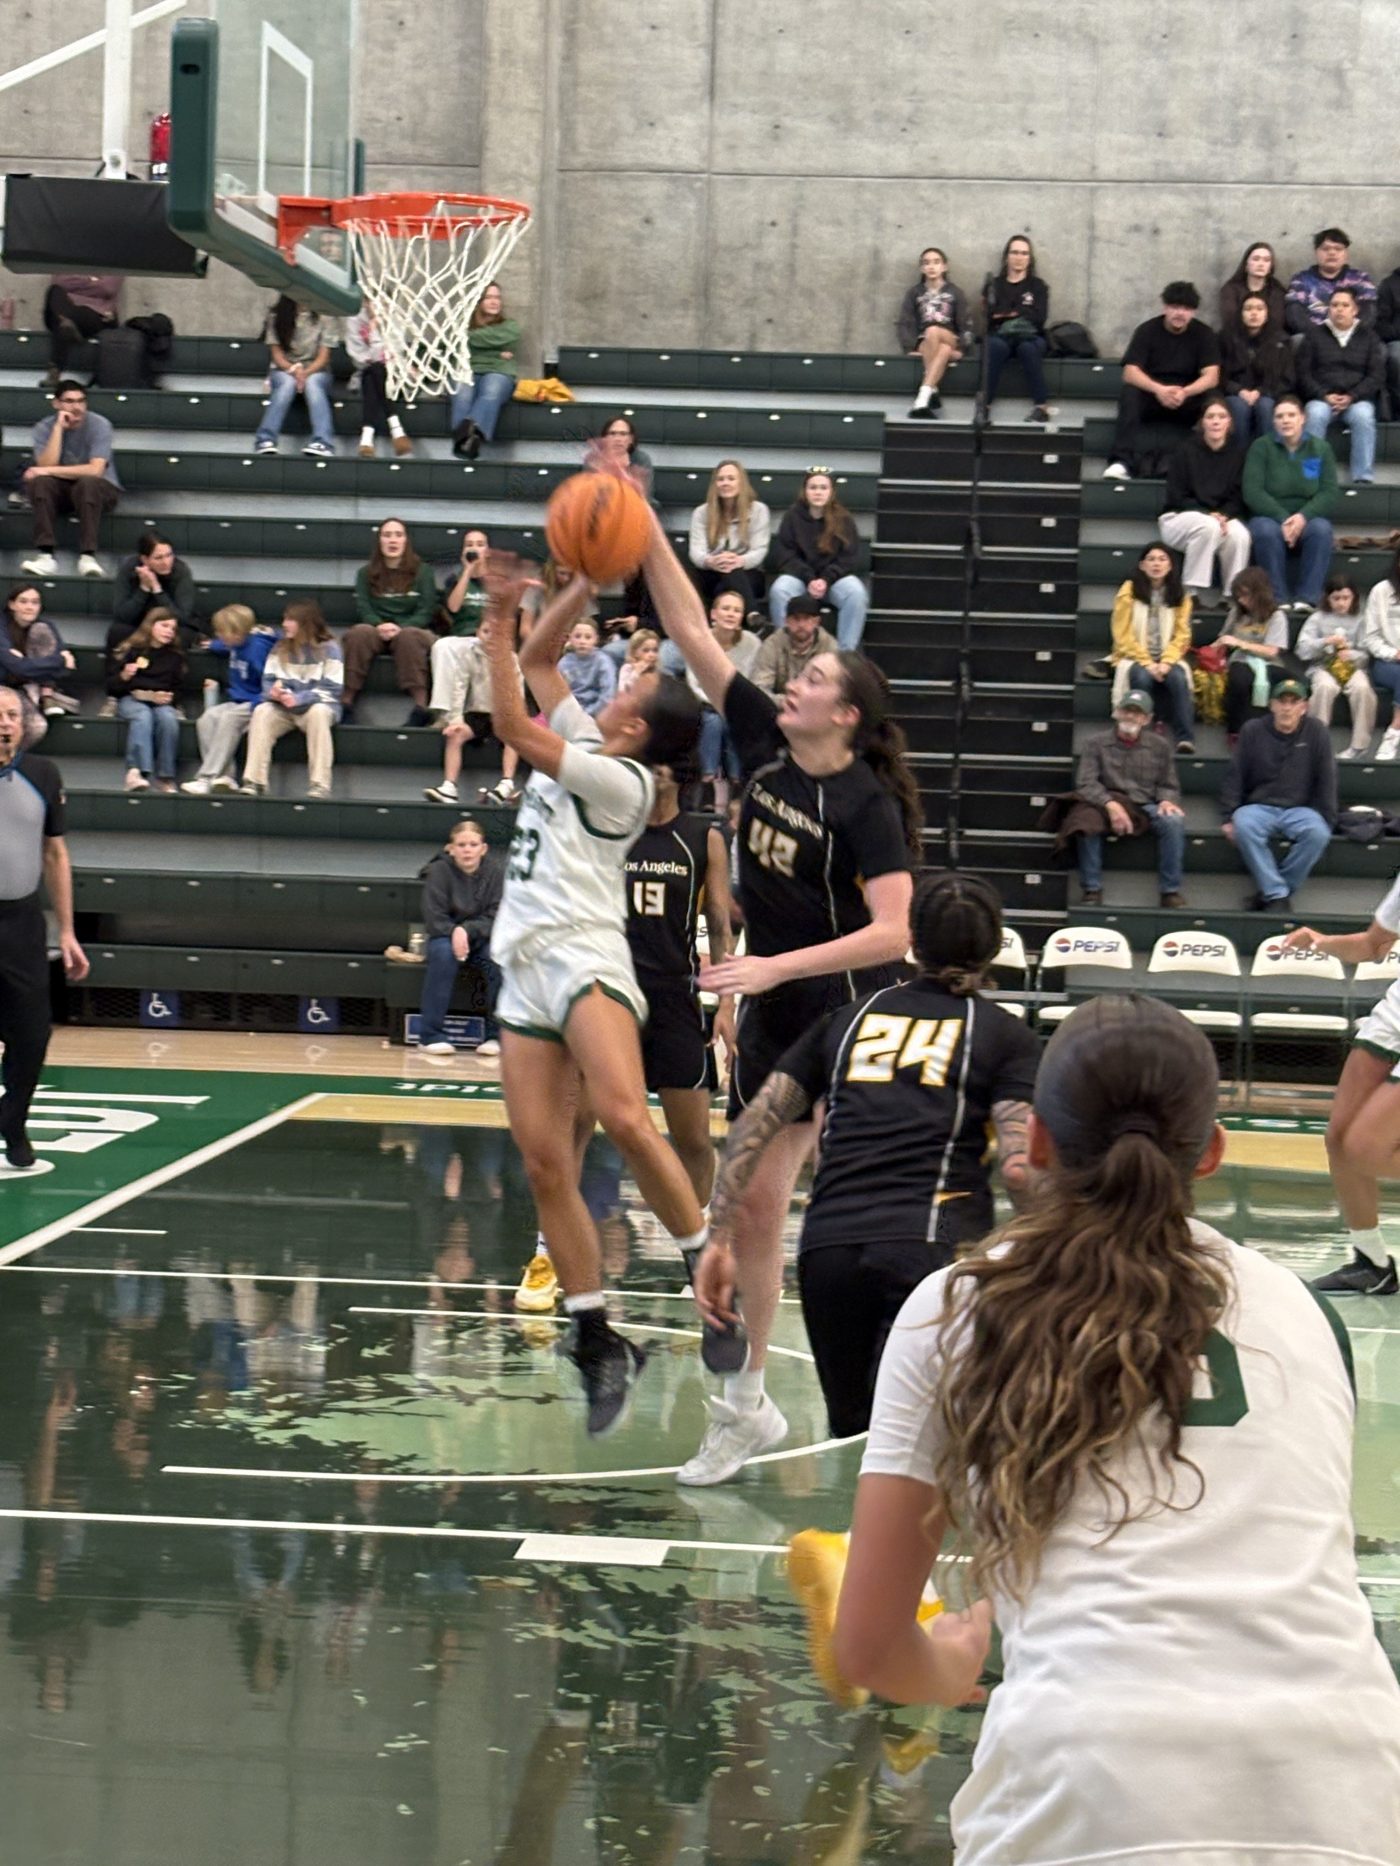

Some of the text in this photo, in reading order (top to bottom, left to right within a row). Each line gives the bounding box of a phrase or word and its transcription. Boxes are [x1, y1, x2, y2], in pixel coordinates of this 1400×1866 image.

[624, 860, 688, 877] os Angeles
[633, 881, 666, 916] 13
[1073, 939, 1121, 953] PEPSI
[1180, 943, 1228, 957] PEPSI
[846, 1013, 963, 1088] 24
